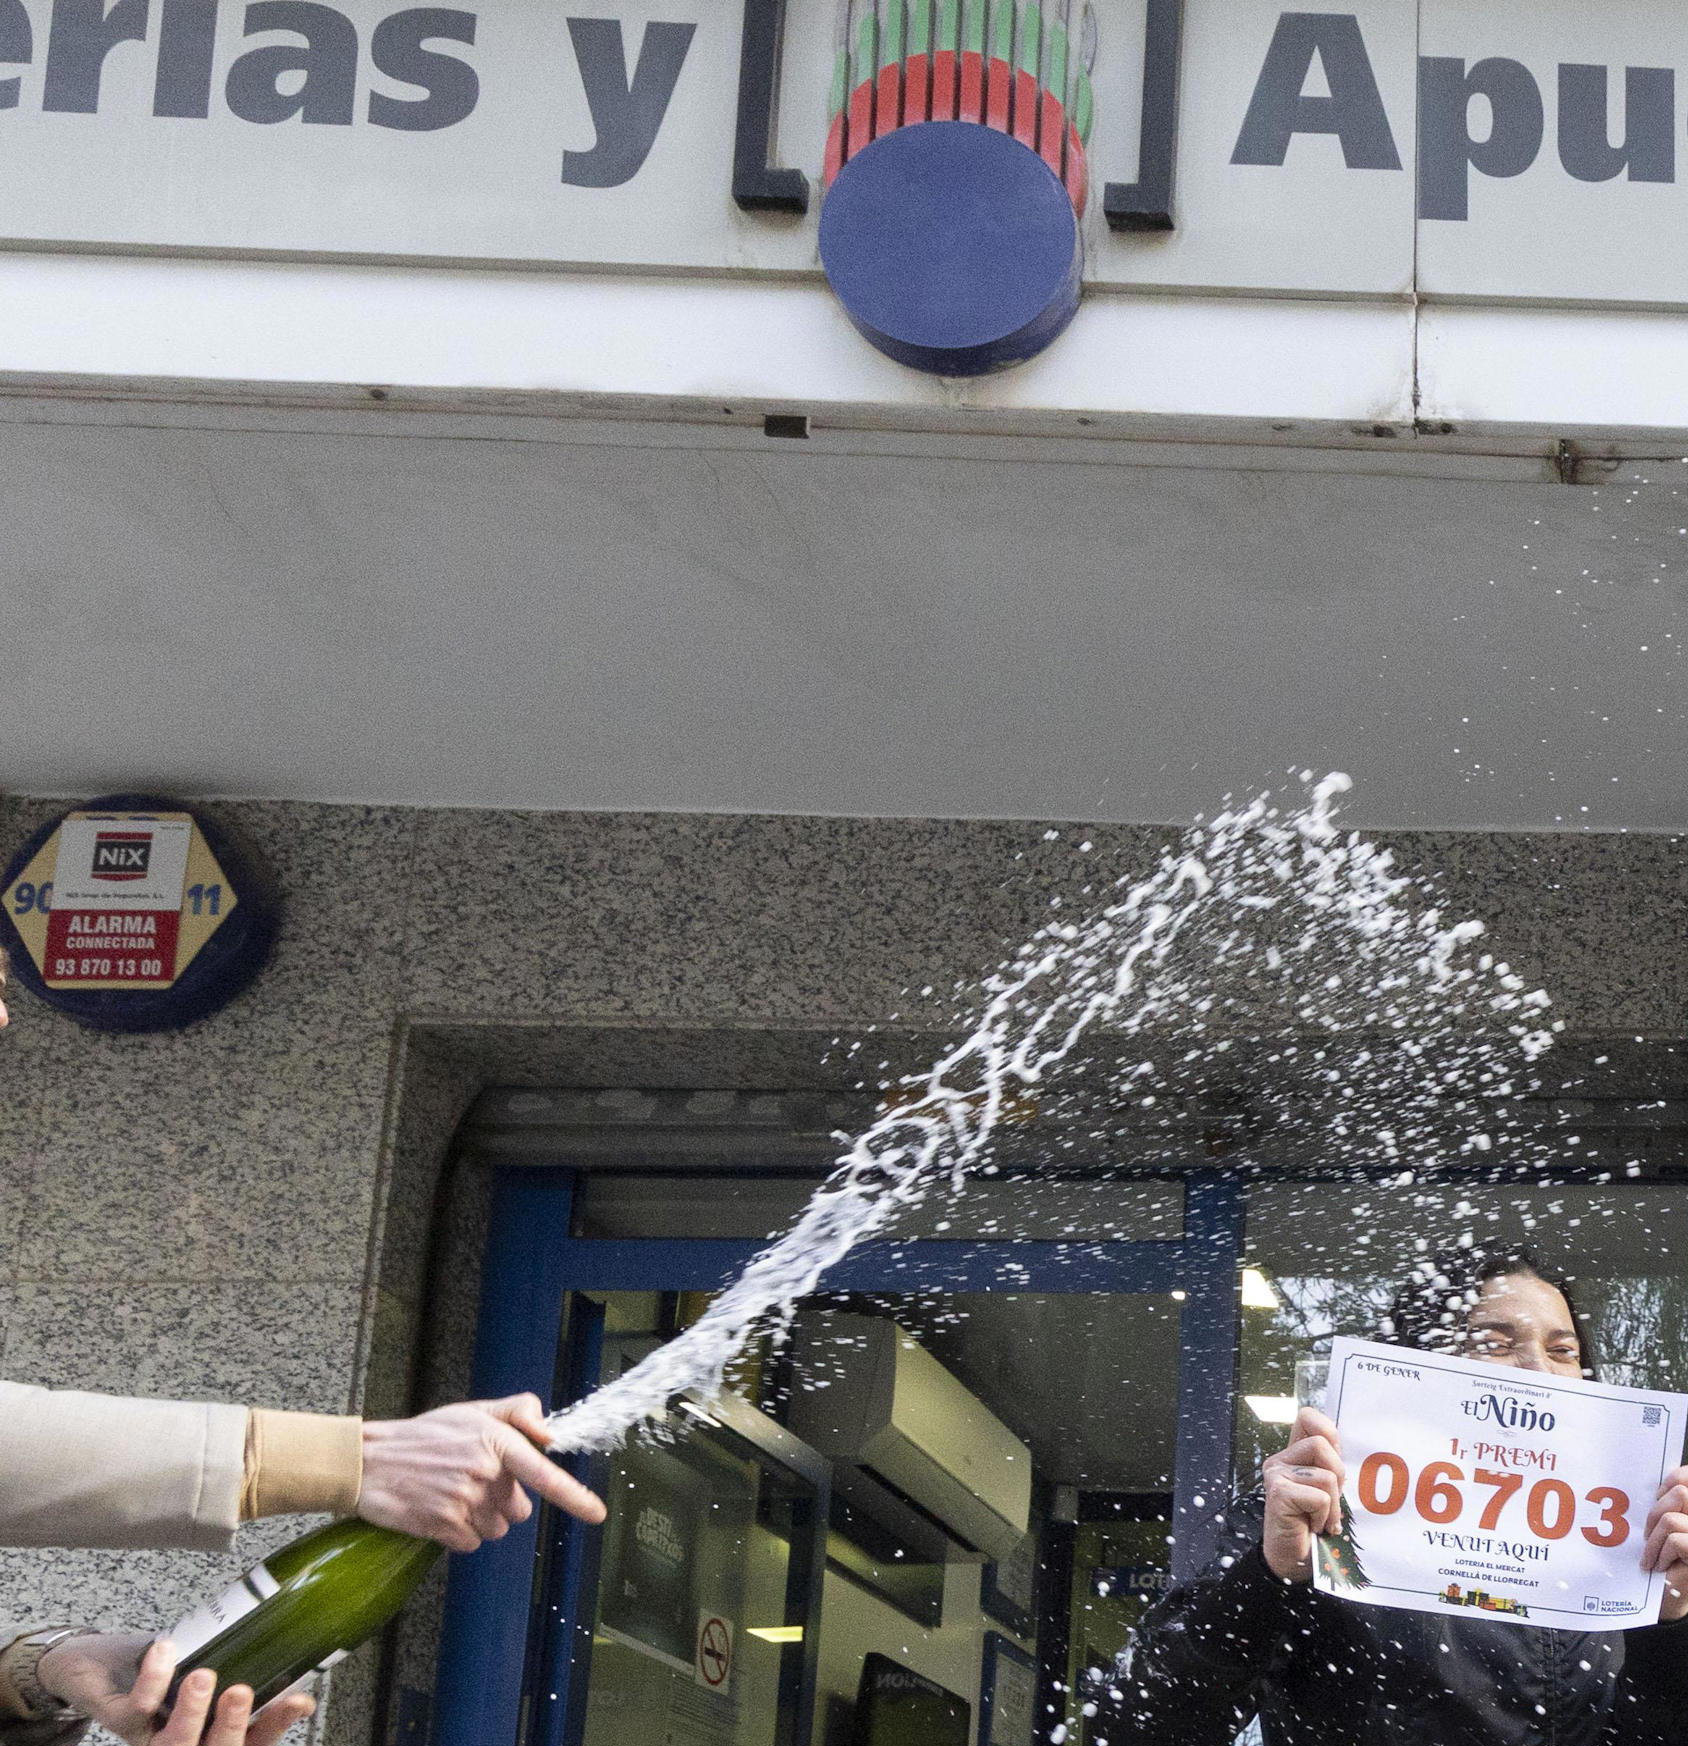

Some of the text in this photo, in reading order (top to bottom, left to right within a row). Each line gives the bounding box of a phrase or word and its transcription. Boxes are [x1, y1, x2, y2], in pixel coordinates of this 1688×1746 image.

[561, 17, 697, 188] y
[187, 883, 222, 916] 11
[68, 915, 157, 935] ALARMA
[66, 936, 155, 950] CONNECTADA
[55, 959, 162, 976] 93 870 13 00
[1357, 1362, 1421, 1381] 6 DE GENER
[1461, 1394, 1556, 1431] El Niño
[1474, 1442, 1557, 1471] PREMI
[1358, 1452, 1631, 1548] 06703
[1423, 1530, 1549, 1562] VENUT AQUÍ
[1455, 1558, 1485, 1569] LOTERIA
[1496, 1564, 1525, 1574] MERCAT
[1482, 1574, 1493, 1582] DE
[1493, 1575, 1540, 1588] LLOBREGAT
